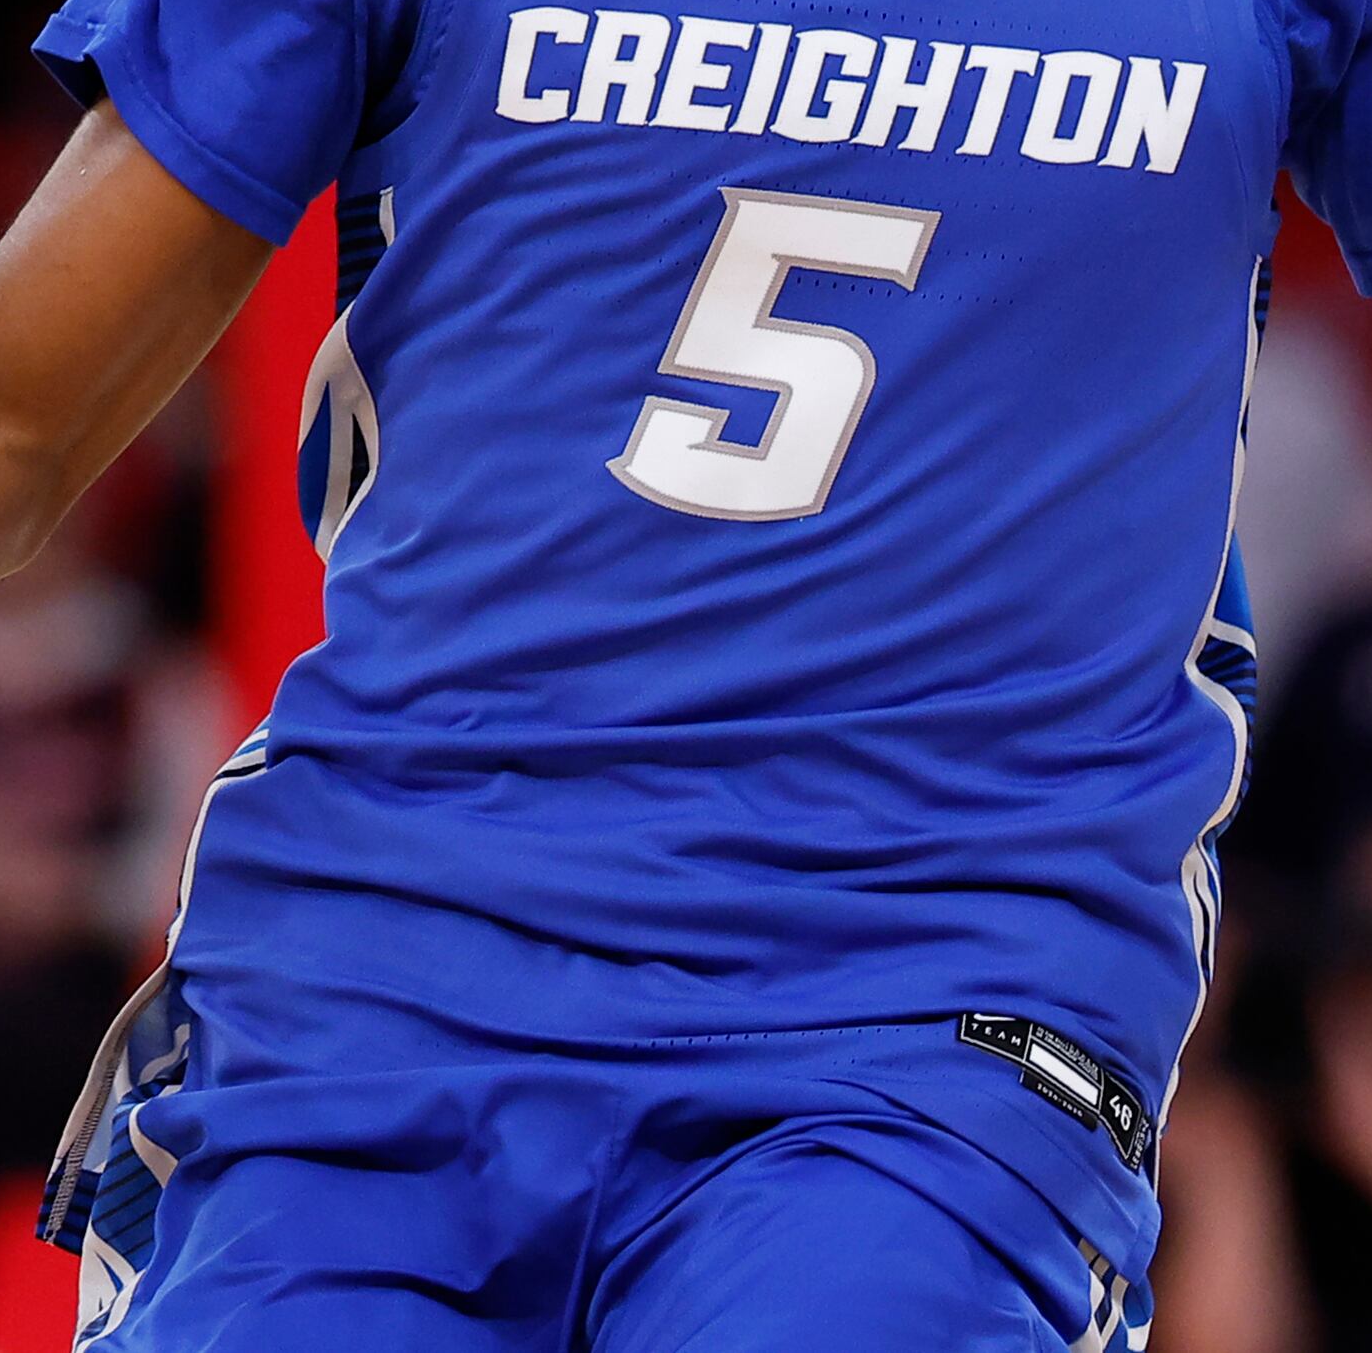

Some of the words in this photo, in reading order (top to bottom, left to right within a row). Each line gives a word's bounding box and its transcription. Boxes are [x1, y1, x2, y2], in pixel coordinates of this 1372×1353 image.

[495, 6, 1206, 174] CREIGHTON
[605, 185, 941, 522] 5
[971, 1023, 1021, 1046] TEAM
[1109, 1095, 1132, 1131] 46
